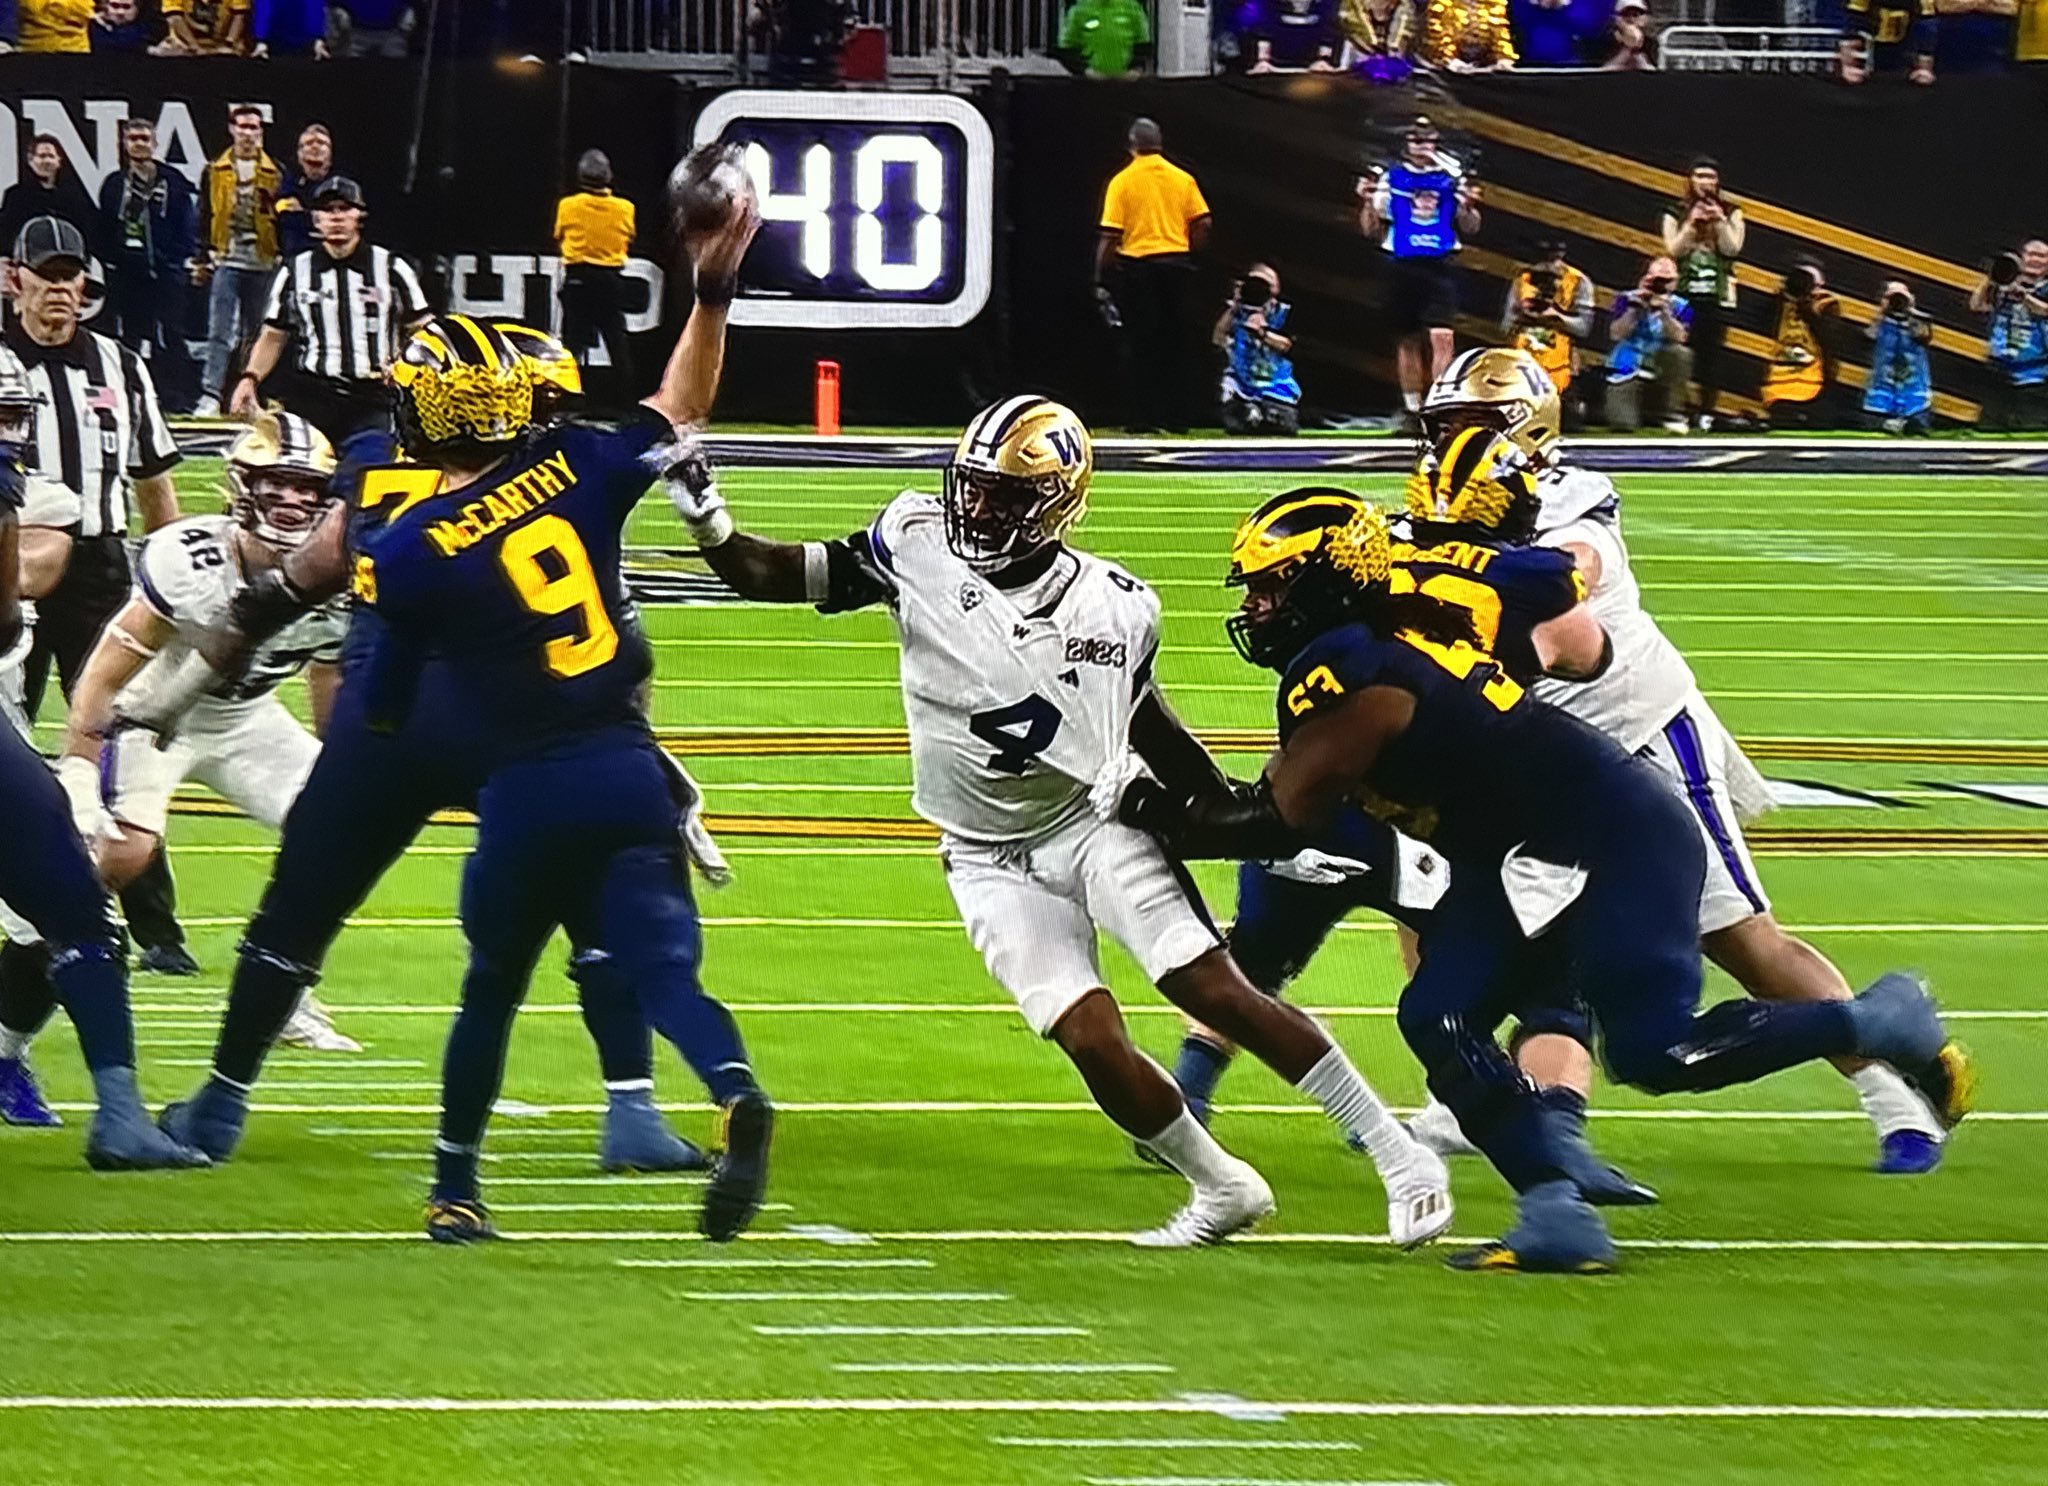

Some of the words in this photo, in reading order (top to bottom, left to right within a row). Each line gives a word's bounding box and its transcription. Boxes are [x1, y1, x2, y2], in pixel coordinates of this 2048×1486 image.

[746, 134, 943, 290] 40
[1045, 426, 1082, 466] W
[179, 528, 225, 570] 42
[424, 450, 577, 556] McCARTHY
[500, 513, 619, 678] 9
[969, 692, 1064, 776] 4
